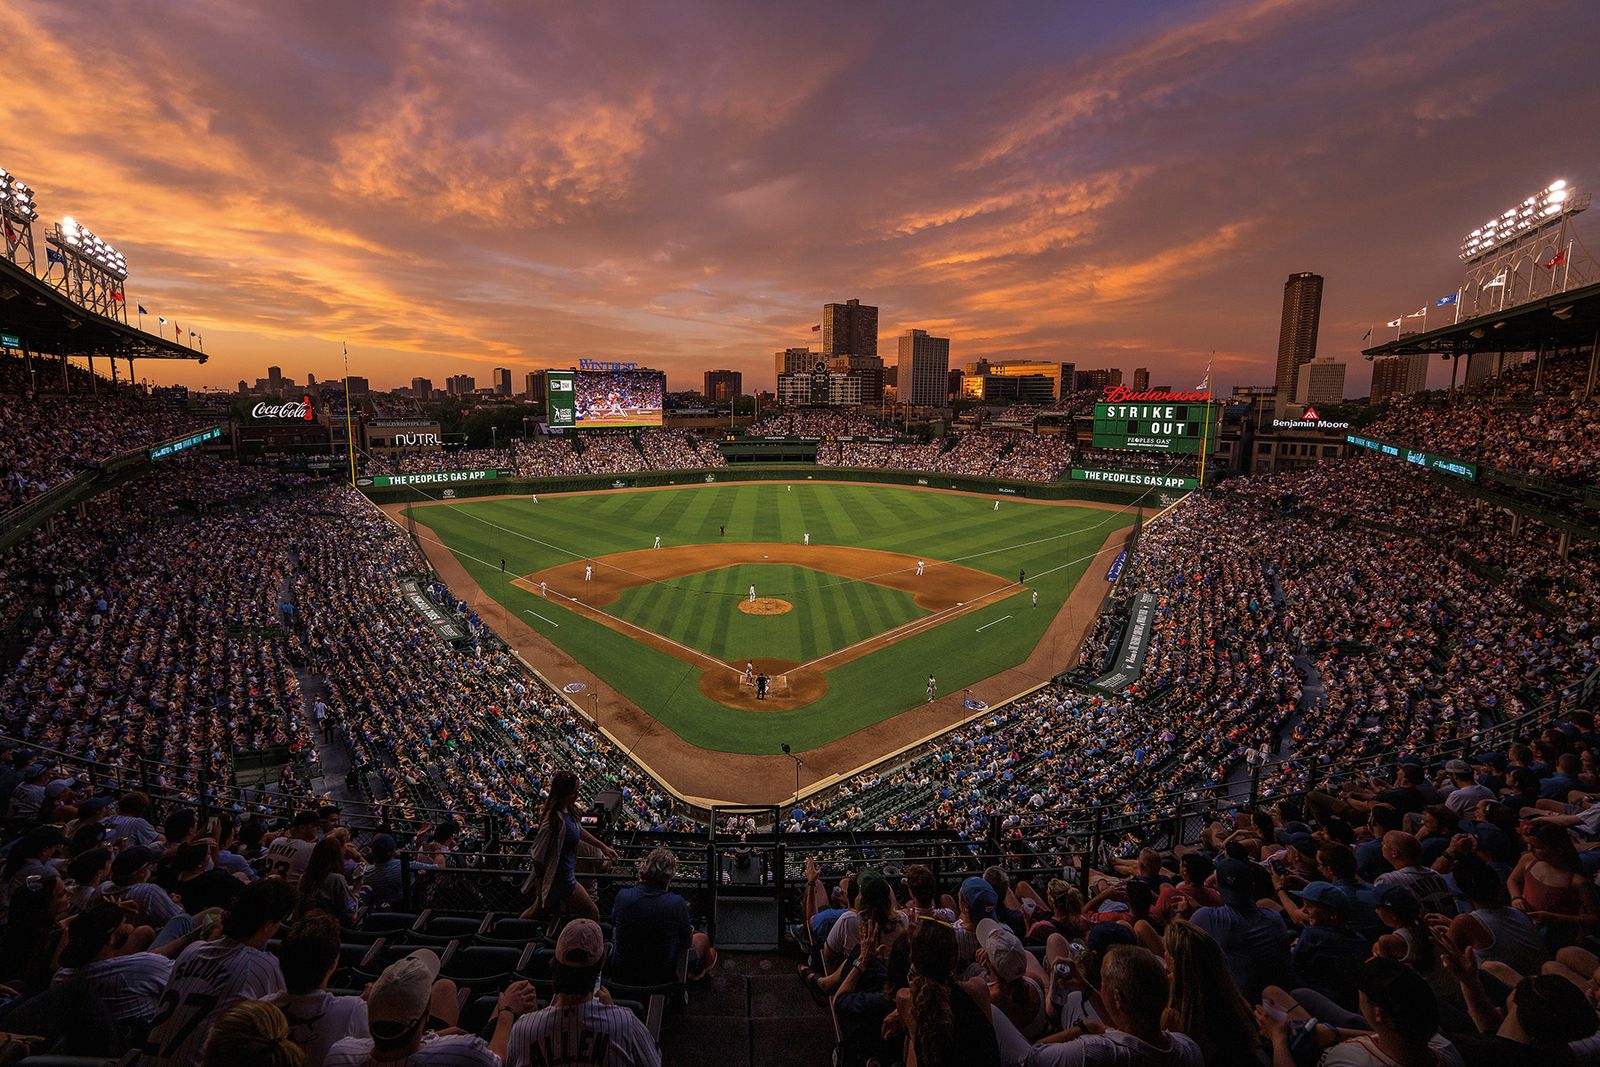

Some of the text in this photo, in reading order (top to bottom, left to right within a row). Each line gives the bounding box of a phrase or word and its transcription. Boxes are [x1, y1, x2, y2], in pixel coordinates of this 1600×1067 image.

[579, 358, 638, 371] WINTRUST
[1103, 385, 1212, 403] Budweiser
[252, 402, 307, 418] Coca-Cola
[1107, 406, 1173, 419] STRIKE
[1151, 422, 1185, 435] OUT
[1272, 419, 1349, 429] Benjamin Moore
[388, 470, 486, 485] THE PEOPLES GAS APP
[1084, 470, 1185, 488] THE PEOPLES GAS APP
